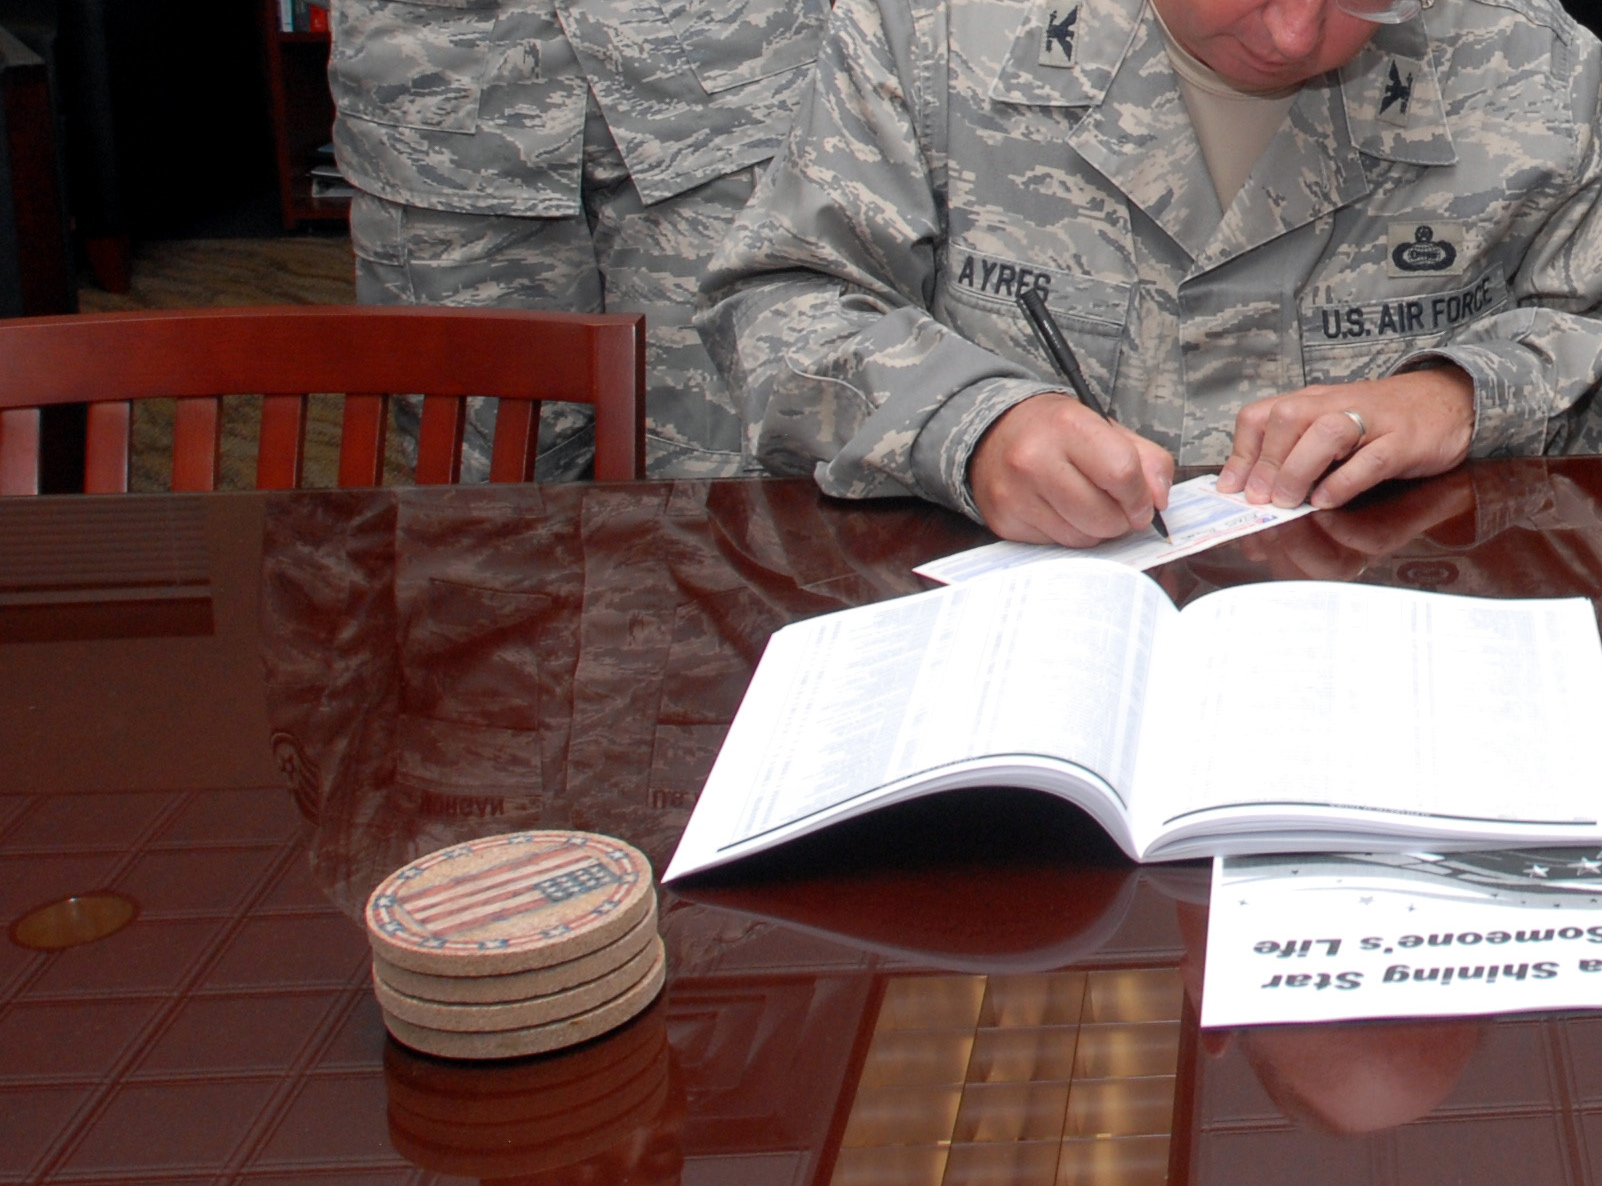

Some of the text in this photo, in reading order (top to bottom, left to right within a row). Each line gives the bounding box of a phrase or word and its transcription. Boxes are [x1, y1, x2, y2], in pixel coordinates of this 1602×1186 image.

[958, 255, 1051, 303] AYRES
[1322, 276, 1493, 339] U.S. AIR FORCE
[1252, 938, 1343, 959] Life
[1260, 970, 1365, 990] Star
[1382, 961, 1560, 985] Shining
